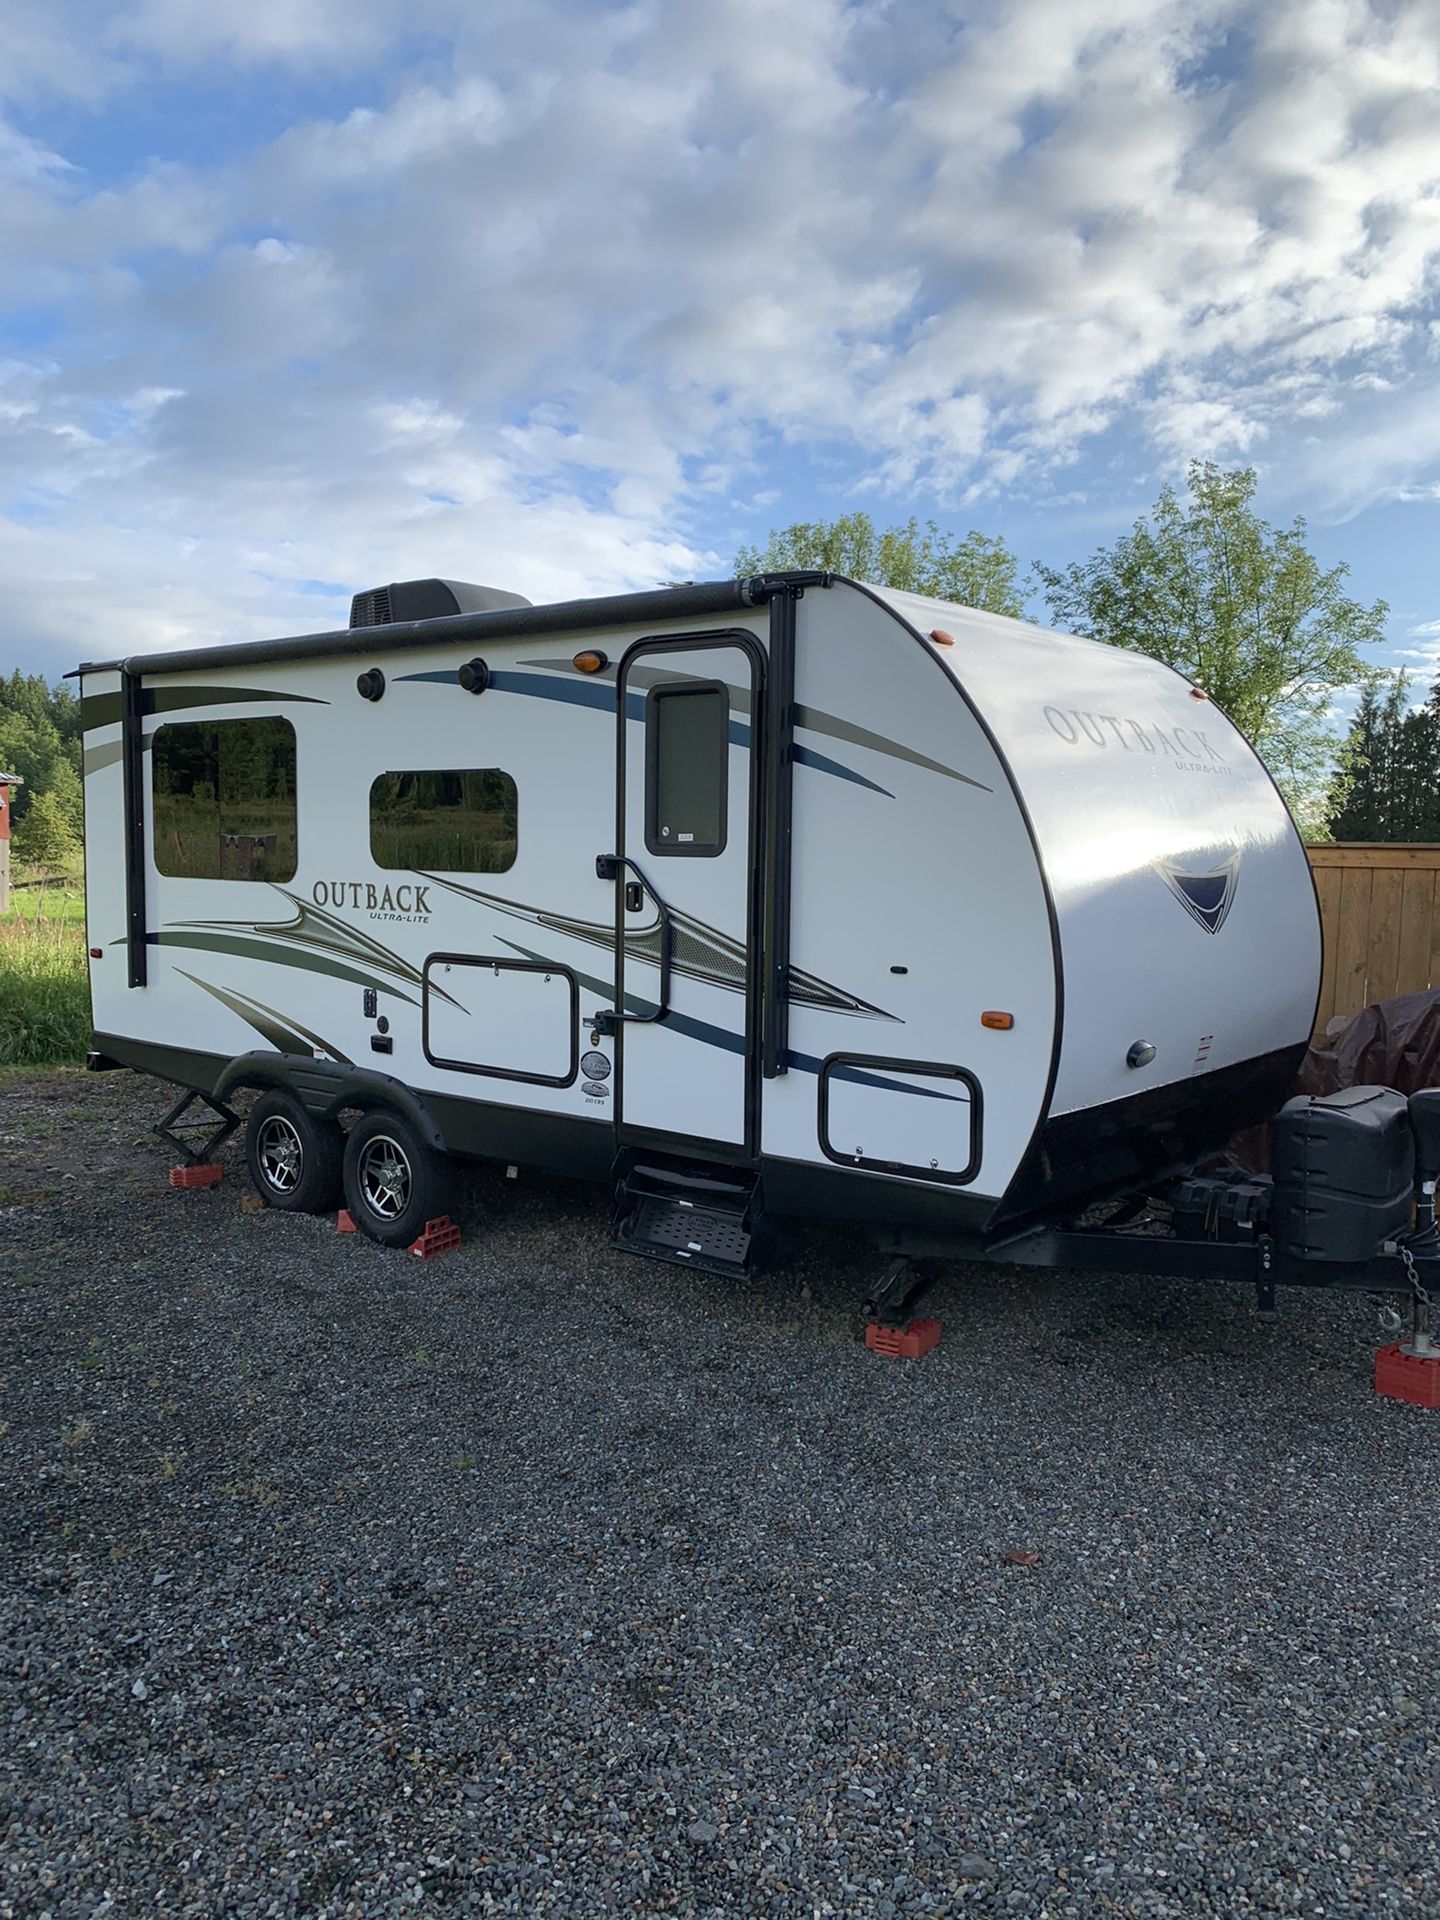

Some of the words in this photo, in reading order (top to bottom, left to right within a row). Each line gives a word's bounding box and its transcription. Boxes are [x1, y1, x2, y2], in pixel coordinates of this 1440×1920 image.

[1043, 705, 1225, 761] OUTBACK
[1175, 761, 1233, 776] ULTRA-LITE
[313, 880, 432, 914] OUTBACK
[369, 912, 430, 923] ULTRA-LITE
